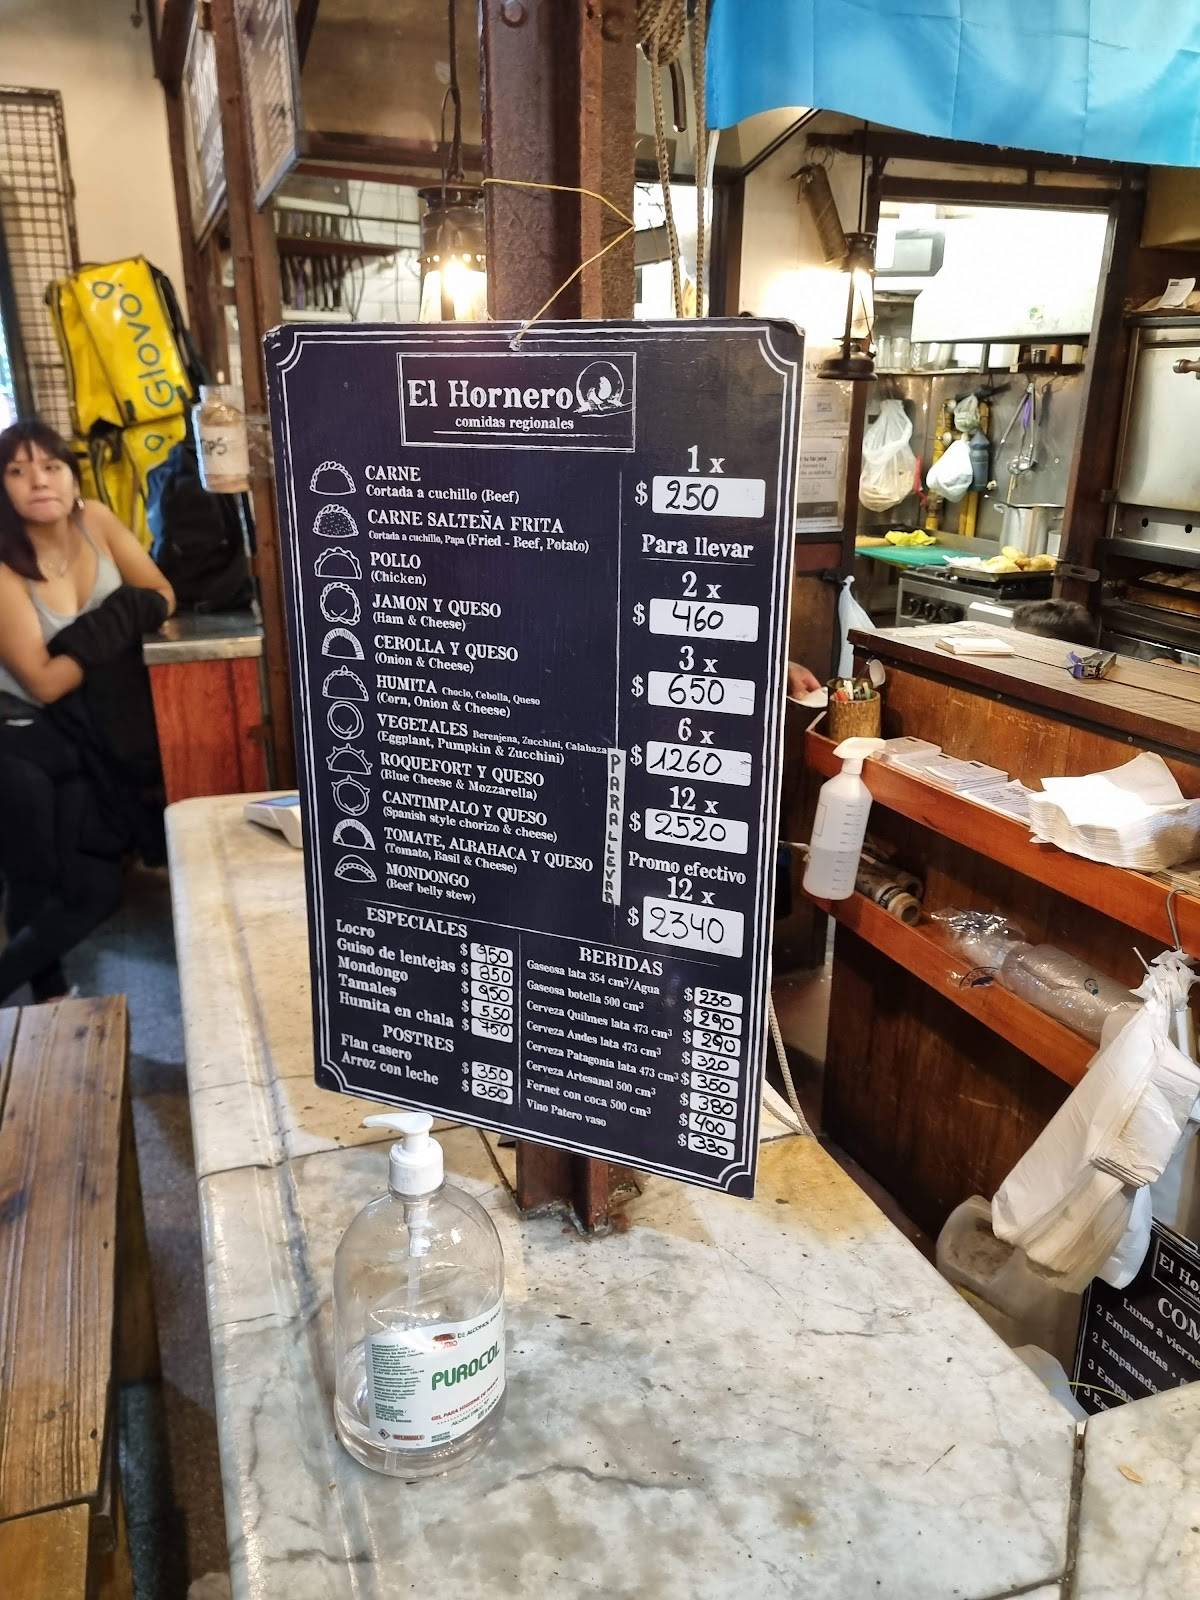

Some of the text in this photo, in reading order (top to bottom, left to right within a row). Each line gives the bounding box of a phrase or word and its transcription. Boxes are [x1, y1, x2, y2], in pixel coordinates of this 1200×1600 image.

[119, 293, 175, 408] Glovo
[407, 379, 573, 409] El Hornero
[455, 415, 574, 432] comidas regionales
[364, 464, 421, 481] CARNE
[687, 445, 700, 473] 1
[365, 483, 519, 504] Cortada cuchillo (Beef)
[666, 479, 720, 512] 250
[367, 508, 564, 533] CARNE SALTEÑA FRITA
[368, 530, 589, 554] Cortada cuchillo, Papa (Fried Beef, Potato)
[641, 533, 754, 558] Para llevar
[369, 551, 421, 569] POLLO
[370, 570, 426, 586] (Chicken)
[681, 570, 698, 598] 2
[371, 593, 501, 617] JAMON QUESO
[672, 601, 724, 632] 460
[372, 611, 466, 632] (Ham Cheese)
[374, 634, 518, 661] CEBOLLA QUESO
[678, 646, 695, 671] 3
[374, 651, 474, 674] (Onion Cheese)
[376, 674, 437, 694] HUMITA
[441, 686, 540, 705] Choclo, Cebolla, Queso
[668, 674, 725, 705] 650
[376, 691, 510, 718] (Corn, Onion Cheese)
[376, 712, 468, 737] VEGETALES
[677, 717, 692, 742] 6
[377, 730, 564, 765] (Eggplant, Pumpkin Zucchini)
[472, 729, 607, 754] Berenjena, Zucchini, Calabaza
[379, 751, 544, 786] ROQUEFORT QUESO
[650, 747, 722, 776] 1260
[380, 768, 537, 801] (Blue Cheese Mozzarella)
[382, 790, 547, 826] CANTIMPALO QUESO
[669, 786, 696, 812] 12
[382, 806, 557, 843] (Spanish style chorizo cheese)
[654, 812, 727, 842] 2520
[383, 826, 593, 872] TOMATE, ALBAHACA QUESO
[384, 842, 517, 874] (Tomato, Basil Cheese)
[385, 862, 469, 888] MONDONGO
[628, 850, 746, 884] Promo efectivo
[386, 877, 476, 904] (Beef belly stew)
[666, 876, 693, 900] 12
[336, 918, 375, 938] Locro
[366, 906, 467, 938] ESPECIALES
[649, 906, 724, 944] 2340
[336, 937, 456, 972] Guiso de lentejas
[578, 946, 663, 976] BEBIDAS
[337, 954, 408, 983] Mondongo
[479, 965, 511, 984] 850
[526, 959, 605, 984] Gaseosa 354
[338, 972, 396, 997] Tamales
[526, 979, 620, 1007] Gaseosa botella 500
[339, 990, 454, 1028] Humita en chala
[699, 990, 732, 1008] 230
[479, 1005, 511, 1021] 550
[526, 1000, 648, 1034] Cerveza Quilmes 473
[699, 1011, 734, 1030] 290
[341, 1033, 412, 1061] Flan casero
[382, 1024, 454, 1052] POSTRES
[526, 1020, 637, 1053] Cerveza Andes 473
[701, 1033, 736, 1052] 290
[341, 1050, 438, 1085] Arroz con leche
[526, 1040, 655, 1077] Cerveza Patagonia 473
[697, 1054, 729, 1072] 320
[476, 1063, 509, 1082] 350
[526, 1059, 632, 1092] Cerveza Artesanal 500
[697, 1074, 730, 1094] 350
[476, 1083, 509, 1100] 350
[526, 1078, 627, 1111] Fernet con coca 500
[526, 1098, 606, 1126] Vino Patero vaso
[698, 1096, 734, 1115] 380
[694, 1114, 726, 1135] 400
[691, 1134, 728, 1156] 330
[1159, 1252, 1174, 1273] El
[1179, 1267, 1200, 1294] Ho
[1123, 1298, 1154, 1330] Lunes
[1105, 1311, 1169, 1372] Empanadas
[431, 1341, 500, 1391] PUROCOL
